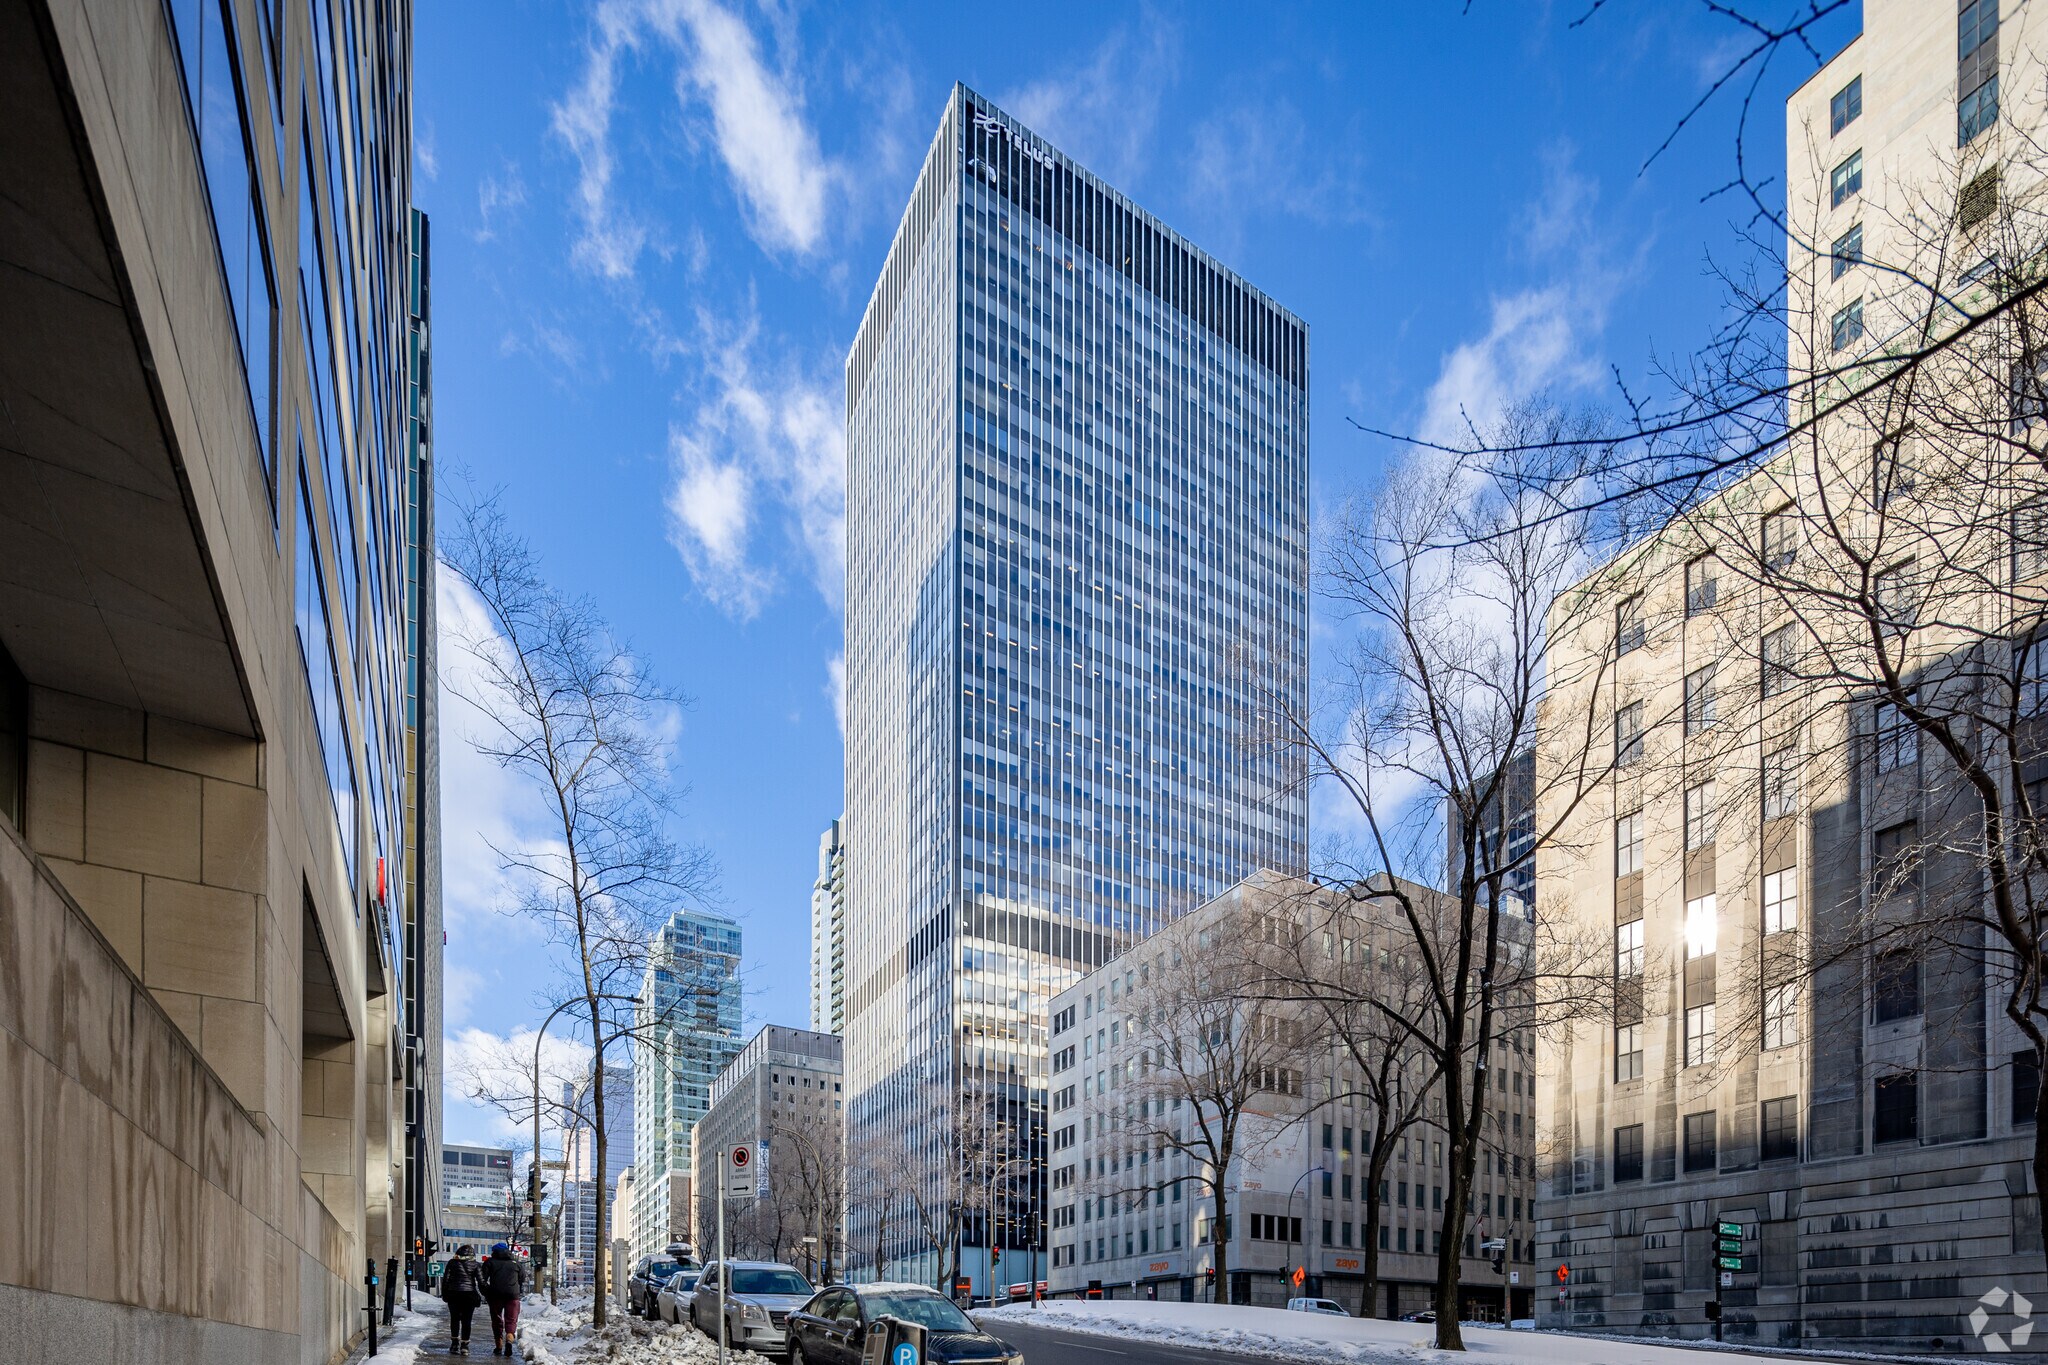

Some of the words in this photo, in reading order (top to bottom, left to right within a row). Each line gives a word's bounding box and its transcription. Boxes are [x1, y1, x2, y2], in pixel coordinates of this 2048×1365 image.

[1004, 128, 1053, 170] TELUS
[1243, 1181, 1262, 1190] zayo
[1149, 1261, 1169, 1272] zayo
[1335, 1258, 1359, 1270] zayo
